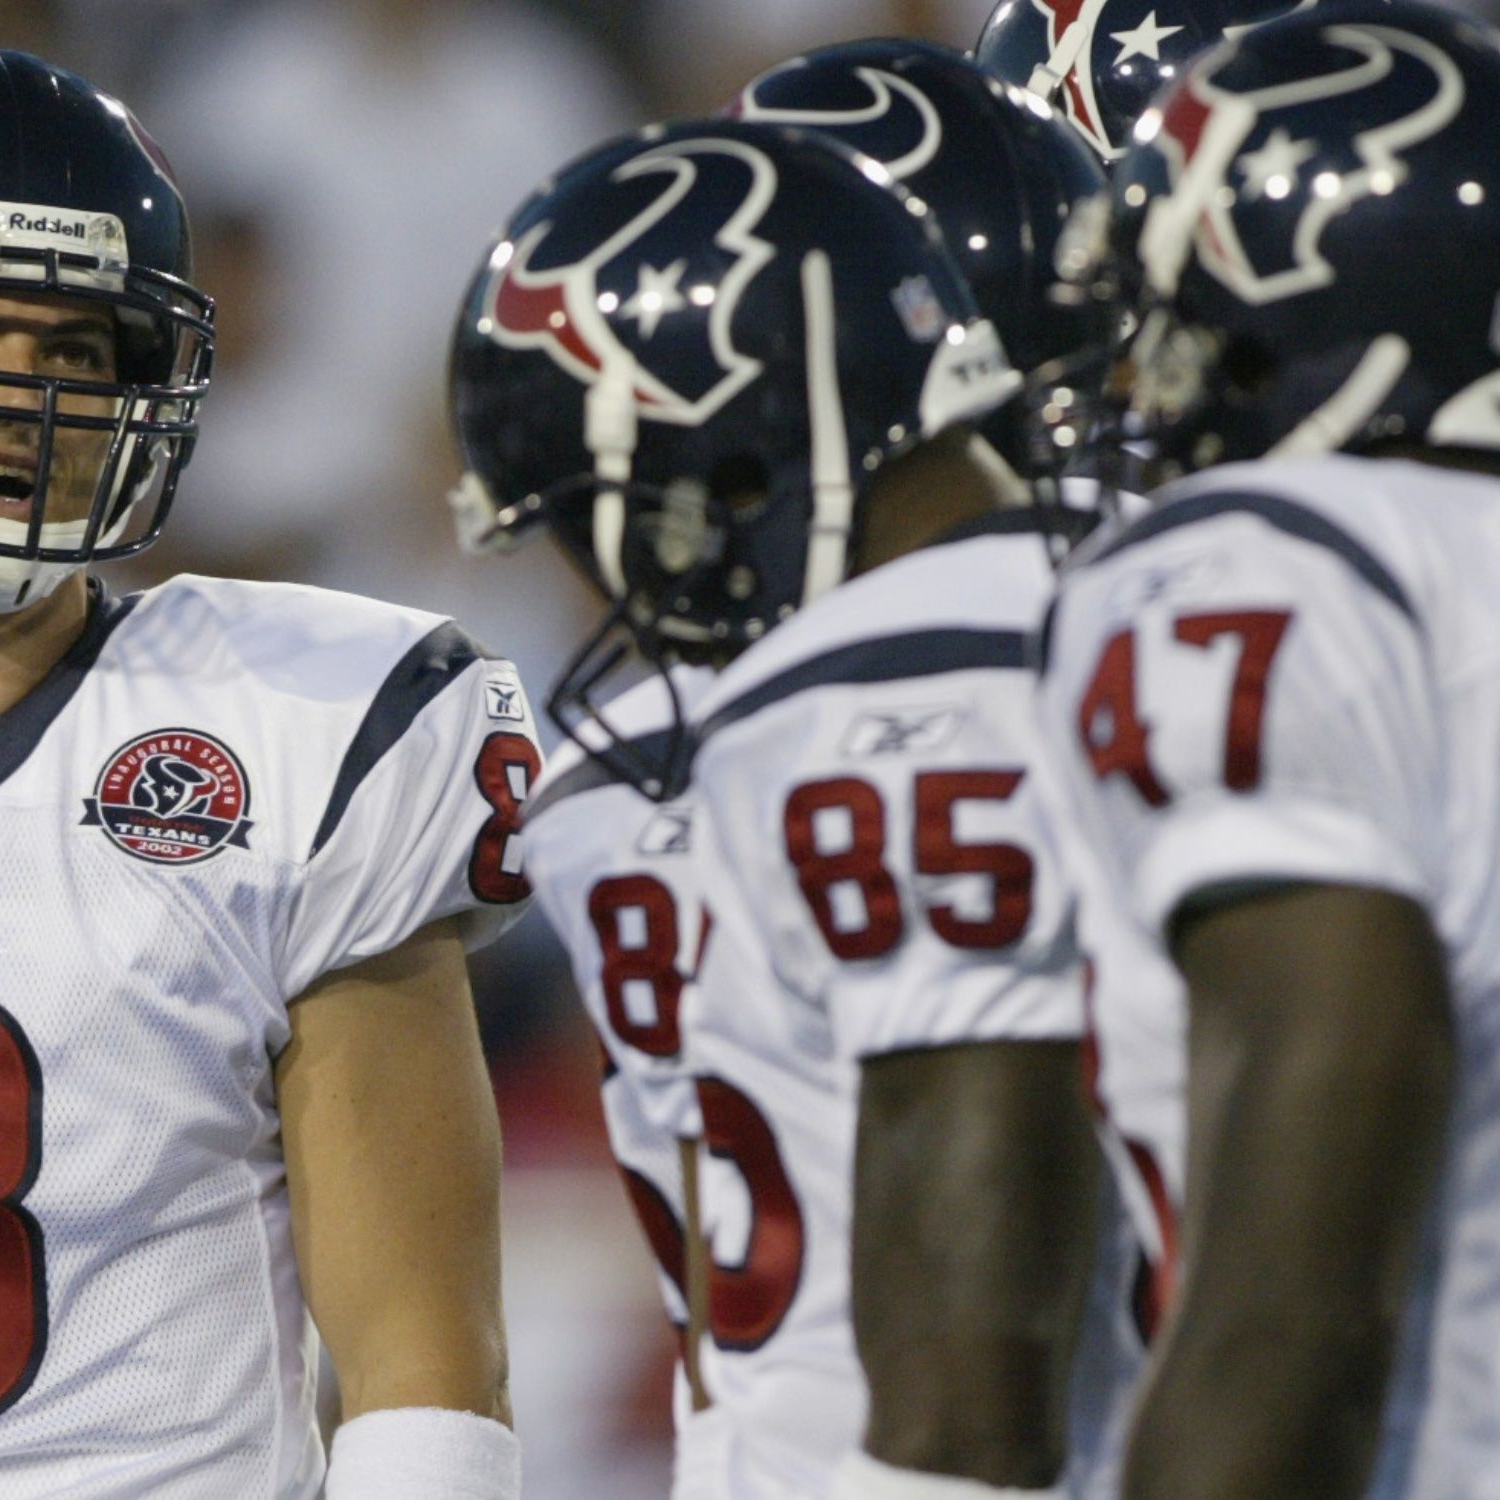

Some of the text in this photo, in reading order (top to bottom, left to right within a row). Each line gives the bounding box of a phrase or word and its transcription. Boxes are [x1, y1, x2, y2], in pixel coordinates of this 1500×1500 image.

[10, 212, 86, 239] Riddell
[1077, 610, 1295, 808] 47
[108, 739, 236, 805] INAUGURAL SEASON
[468, 730, 542, 905] 8
[114, 822, 211, 846] TEXANS
[136, 841, 183, 856] 2002
[782, 766, 1036, 962] 85
[587, 872, 714, 1060] 8
